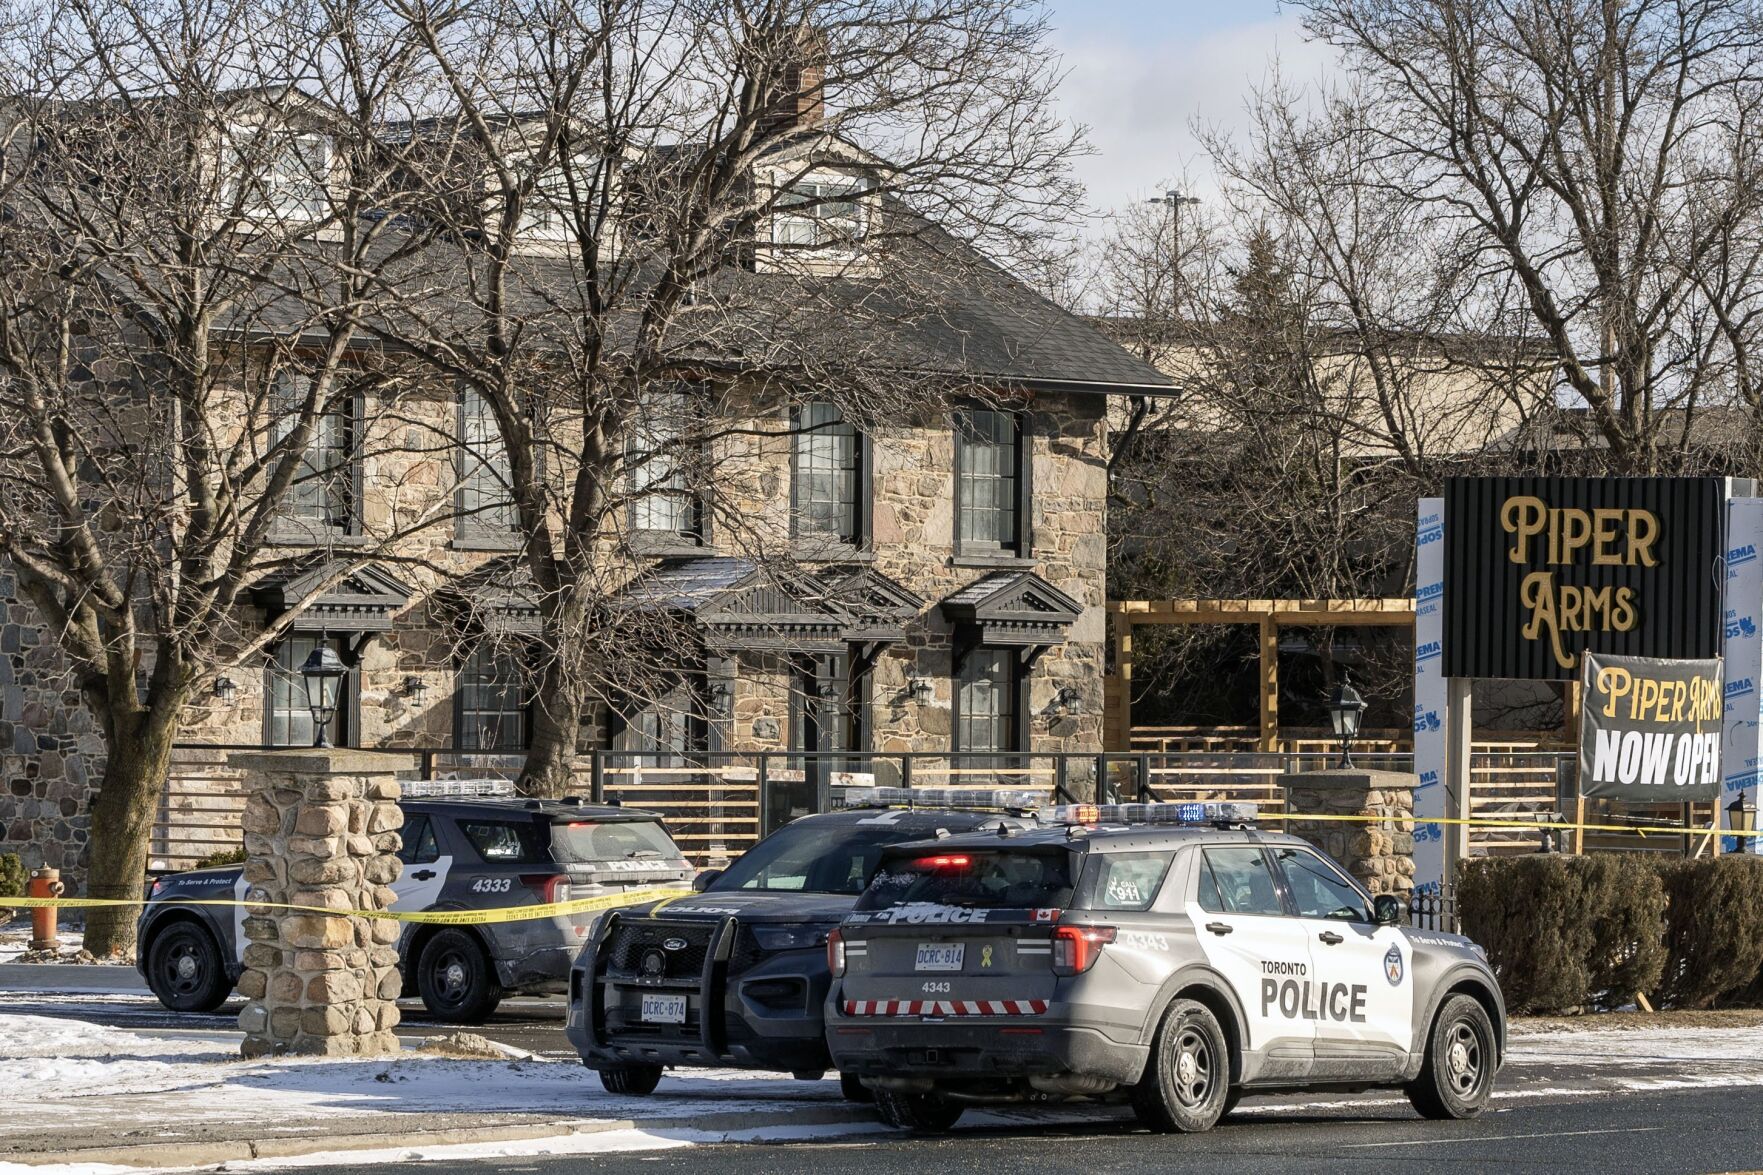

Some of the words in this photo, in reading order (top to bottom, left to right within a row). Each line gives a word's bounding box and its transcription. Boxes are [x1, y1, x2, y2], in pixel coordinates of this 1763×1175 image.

[1500, 495, 1662, 567] PIPER
[1727, 544, 1755, 560] EMA
[1520, 572, 1638, 669] ARMS
[1416, 640, 1441, 657] EMA
[1596, 666, 1687, 722] PIPER
[1687, 675, 1721, 734] ARMS
[1592, 728, 1675, 785] NOW
[1673, 732, 1720, 786] OPEN
[607, 860, 671, 872] POLICE
[472, 879, 511, 893] 4333
[1120, 880, 1137, 888] CALL
[1261, 960, 1307, 976] TORONTO
[921, 982, 951, 993] 4343
[1261, 978, 1368, 1023] POLICE
